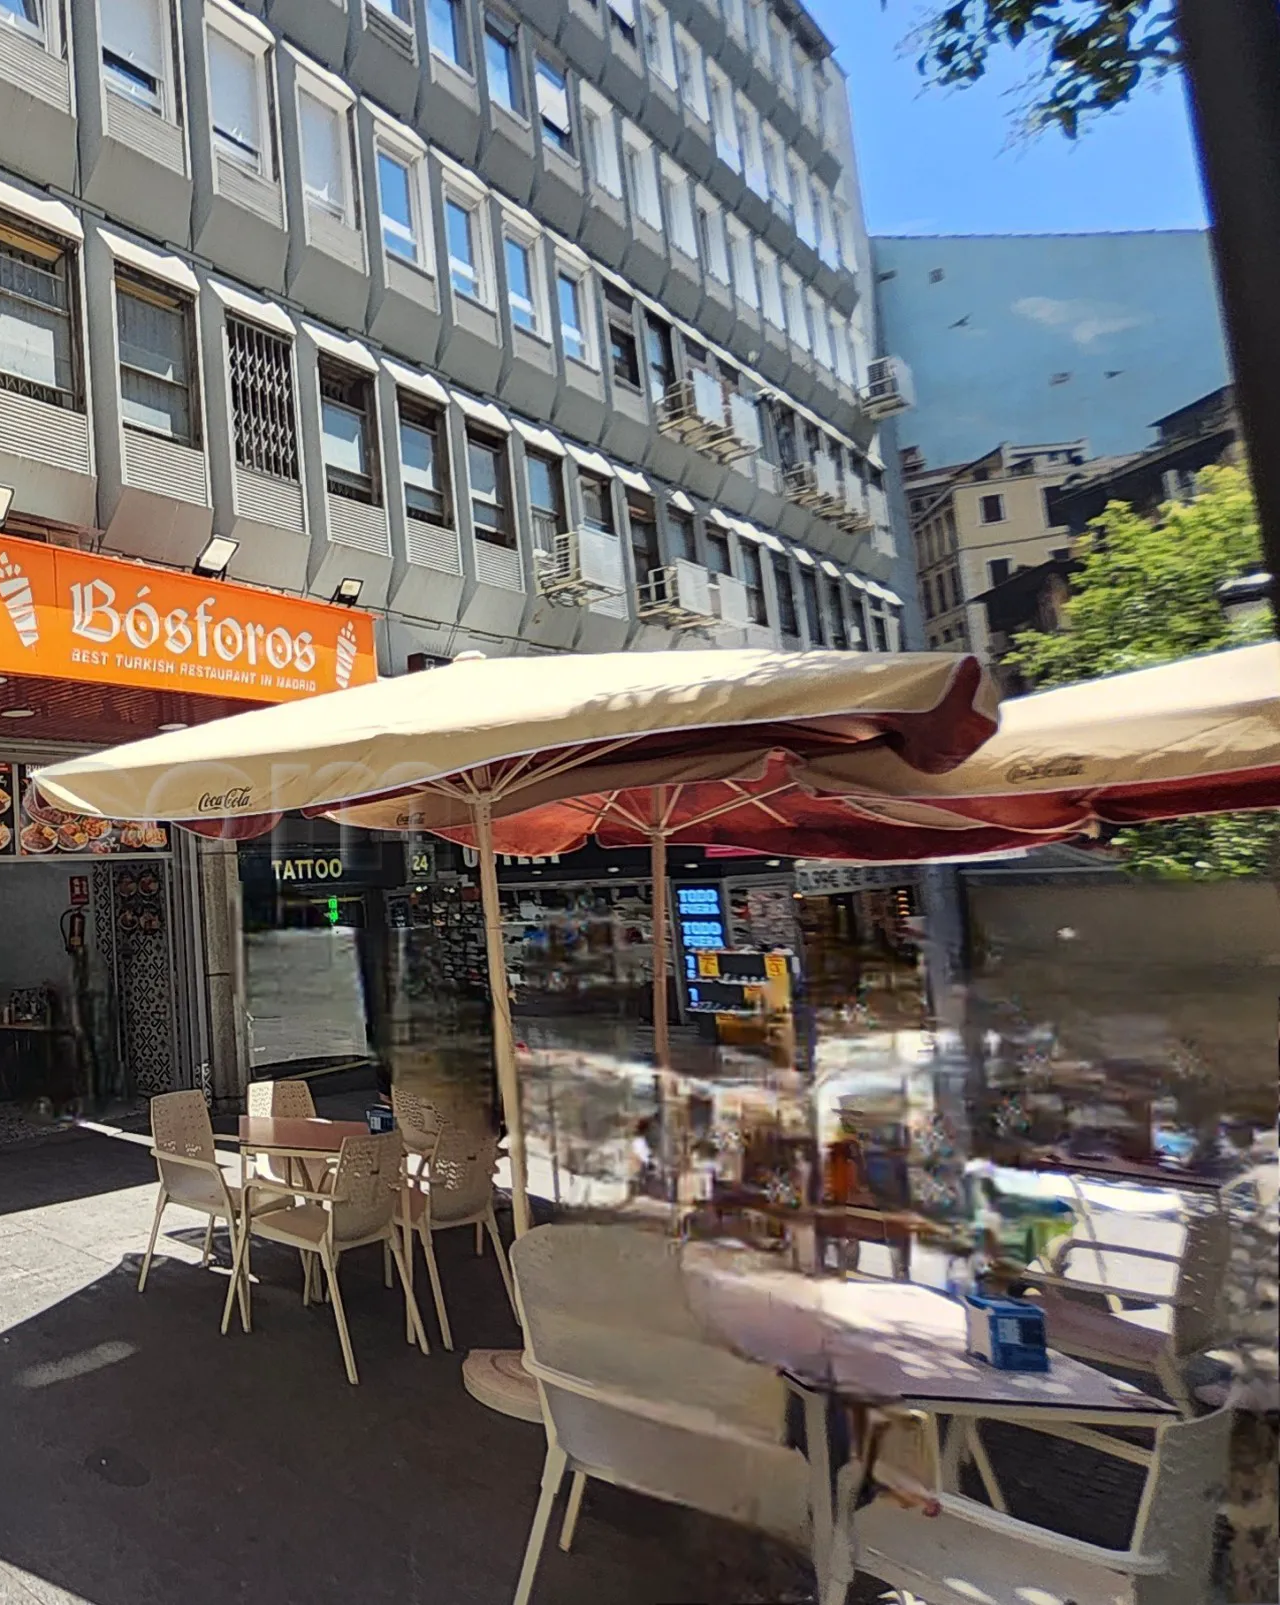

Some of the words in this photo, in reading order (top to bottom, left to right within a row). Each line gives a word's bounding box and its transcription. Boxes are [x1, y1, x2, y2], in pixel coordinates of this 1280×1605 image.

[70, 578, 317, 673] Bósforos
[71, 647, 109, 665] BEST
[115, 651, 175, 675] TURKISH
[180, 661, 256, 687] RESTAURANT
[260, 674, 272, 688] IN
[276, 676, 317, 693] MADRID
[272, 857, 343, 881] TATTOO
[412, 855, 428, 871] 24
[677, 889, 718, 902] TODO
[681, 921, 722, 935] TODO
